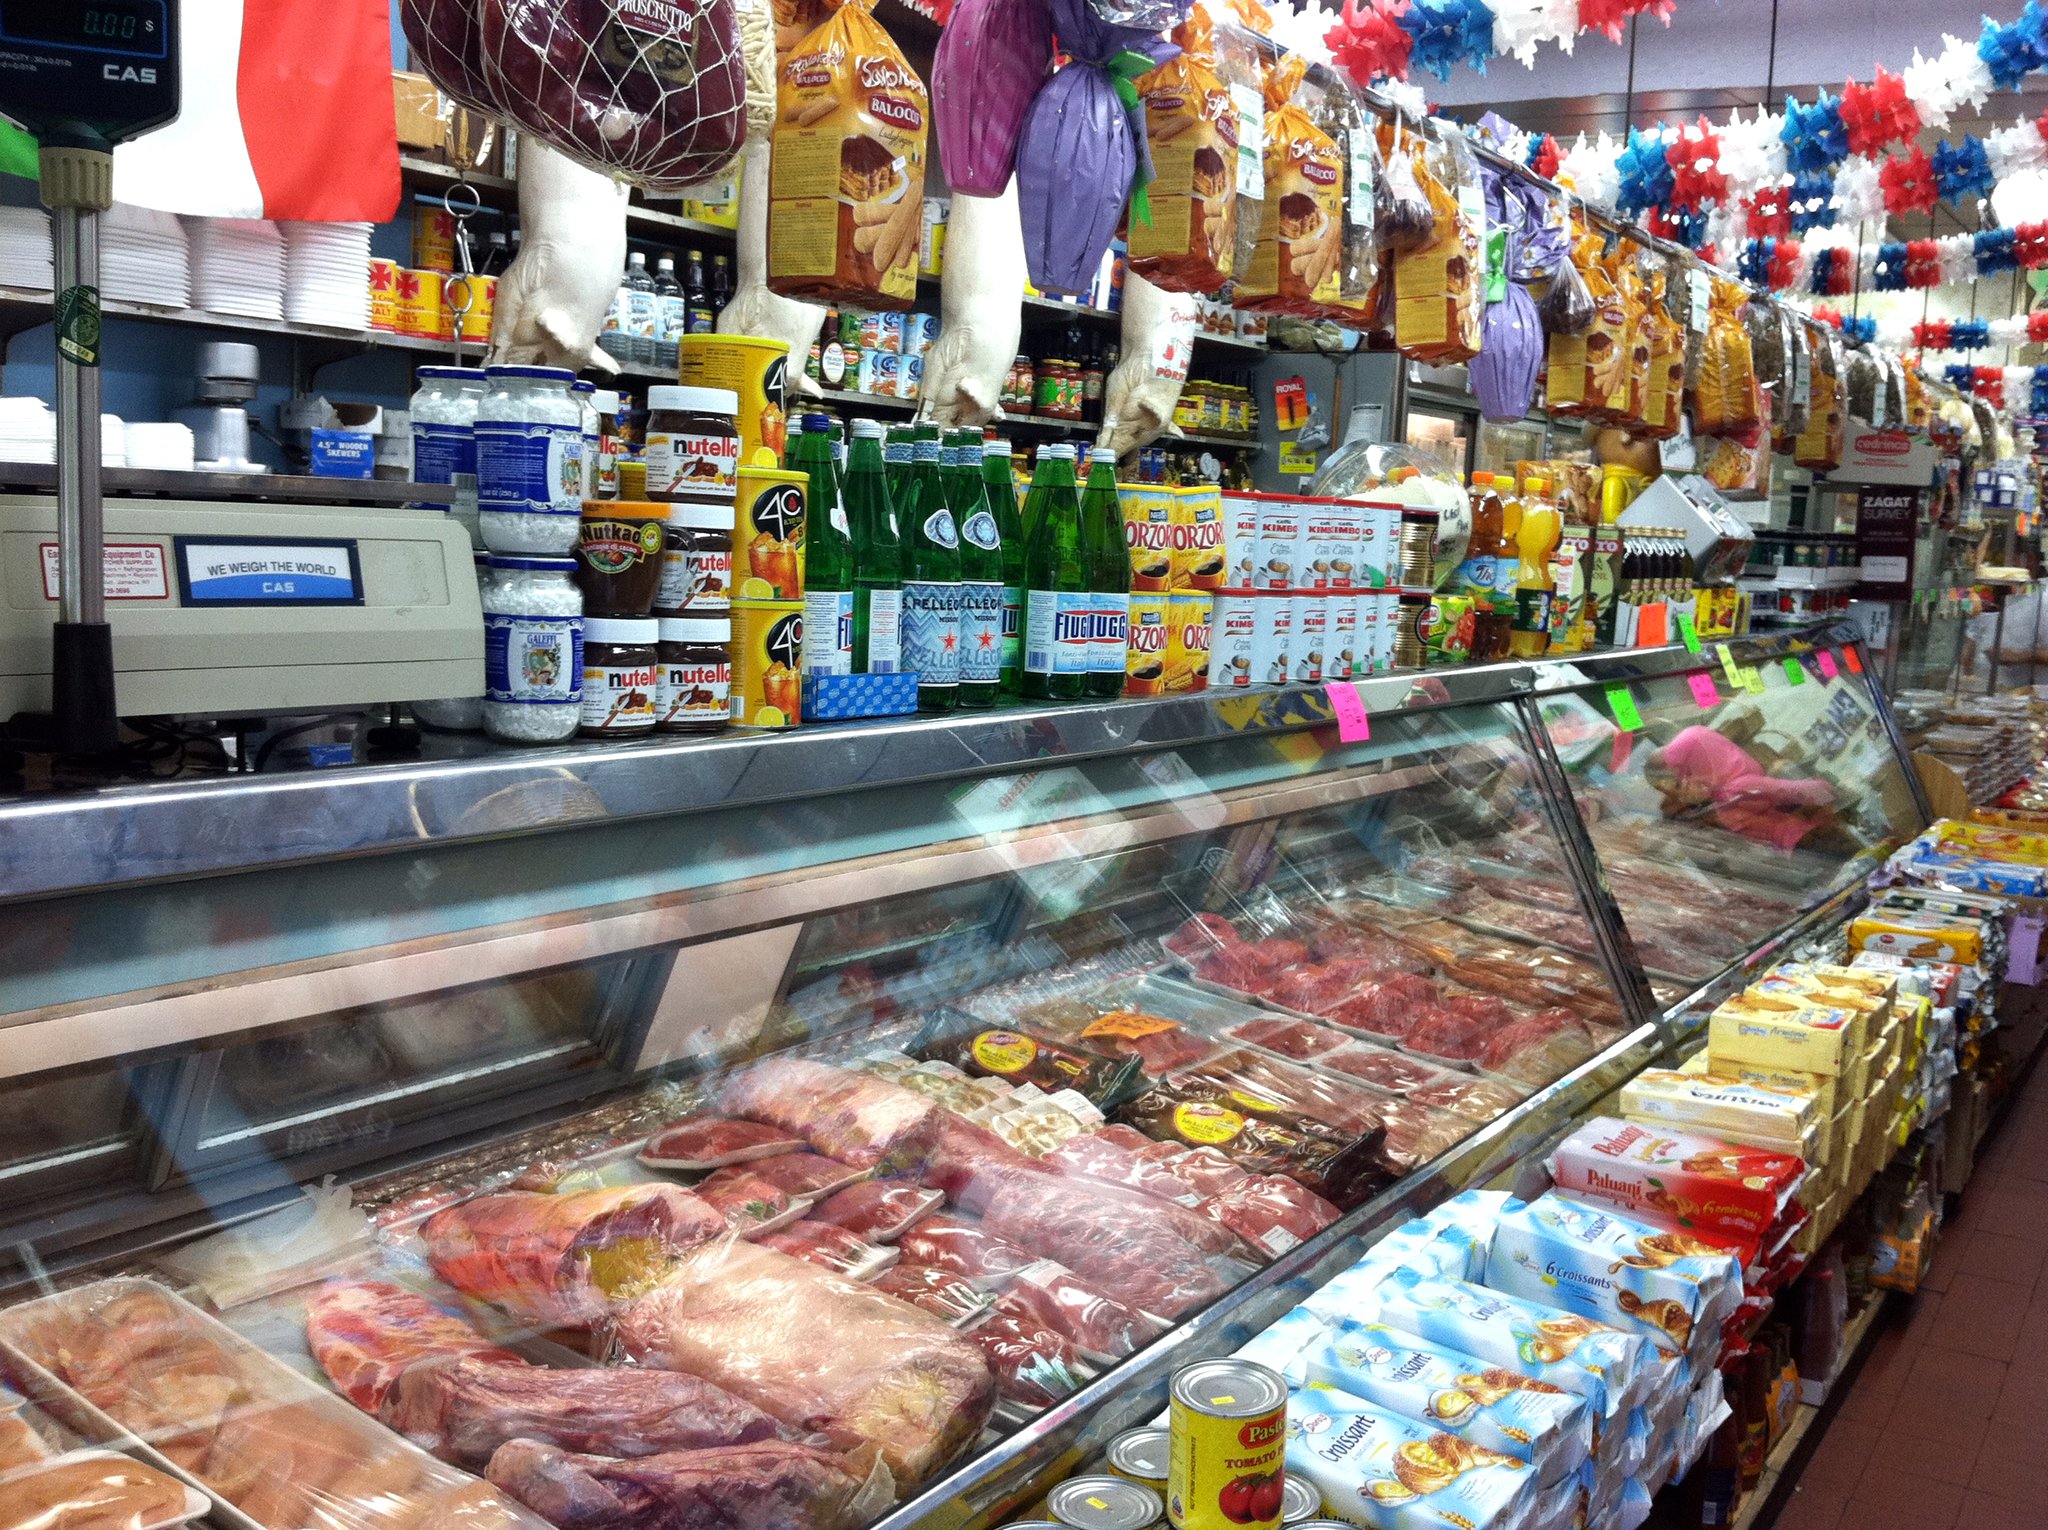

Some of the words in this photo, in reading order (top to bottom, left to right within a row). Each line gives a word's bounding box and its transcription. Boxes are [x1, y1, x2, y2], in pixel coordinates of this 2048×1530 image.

[145, 19, 155, 33] $
[103, 63, 157, 85] CAS
[1276, 384, 1303, 394] ROYAL
[673, 436, 738, 458] nutella
[1863, 496, 1912, 508] ZAGAT
[1863, 508, 1911, 520] SURVEY
[581, 523, 641, 545] Nutkao
[1262, 523, 1299, 533] KIMBO
[206, 563, 227, 576] WE
[229, 561, 268, 573] WEIGH
[270, 561, 293, 572] THE
[295, 562, 337, 576] WORLD
[262, 582, 295, 594] CAS
[670, 663, 731, 685] nutella
[1591, 1125, 1654, 1157] Paluani
[1586, 1168, 1642, 1195] Paluani
[1702, 1200, 1715, 1214] 6
[1546, 1260, 1557, 1275] 6
[1556, 1267, 1611, 1289] Croissants
[1318, 1413, 1376, 1463] Croissant
[1224, 1450, 1276, 1469] TOMATO
